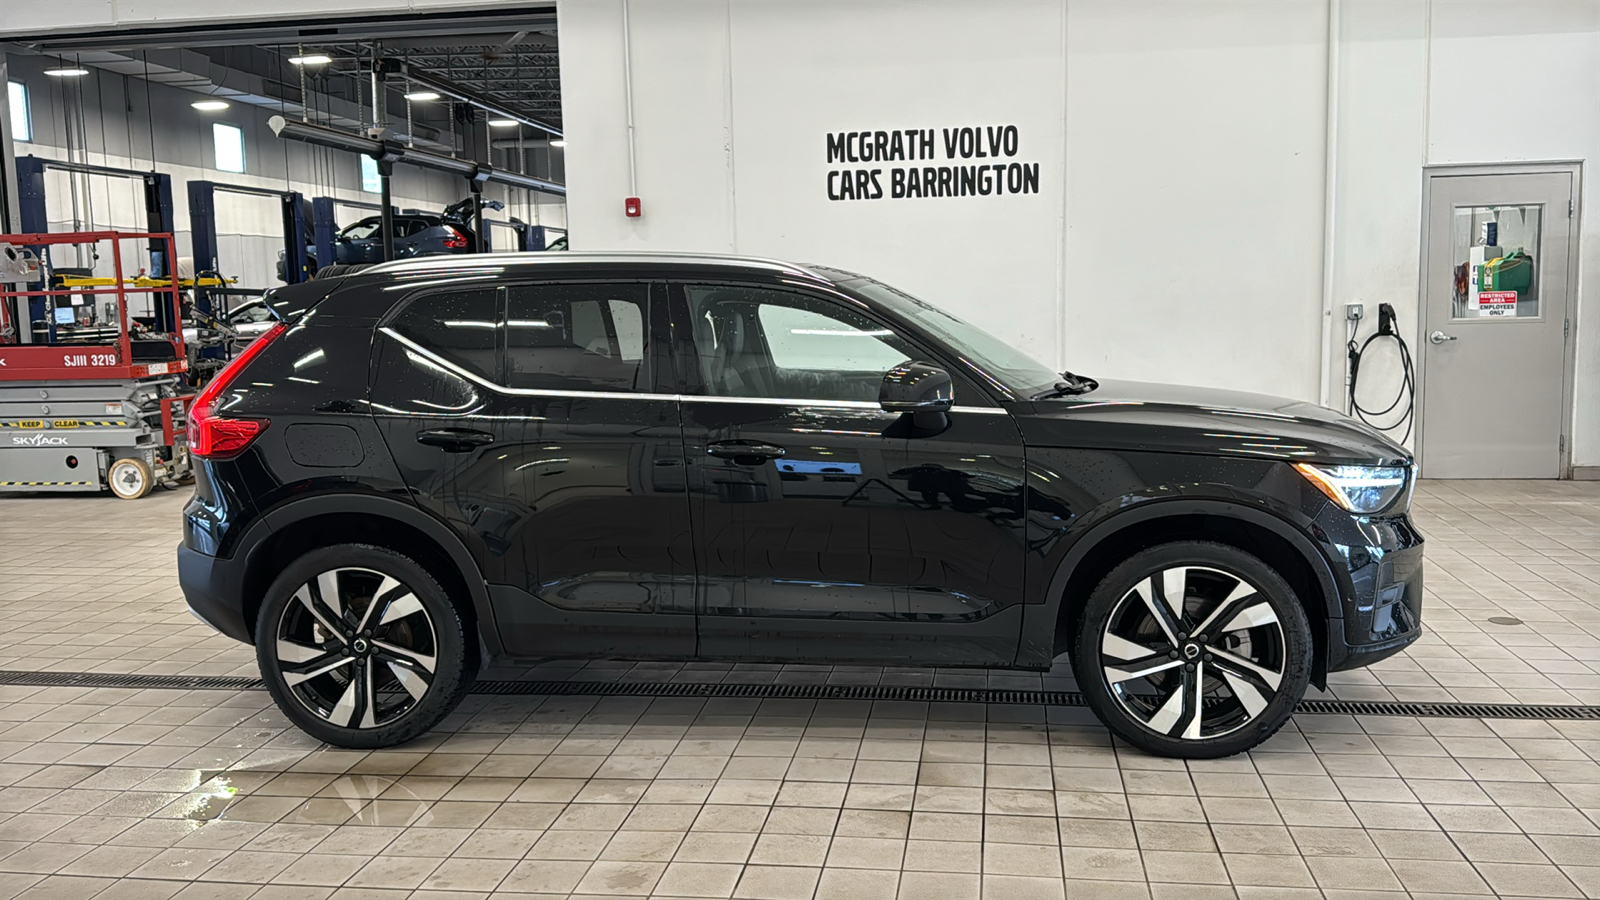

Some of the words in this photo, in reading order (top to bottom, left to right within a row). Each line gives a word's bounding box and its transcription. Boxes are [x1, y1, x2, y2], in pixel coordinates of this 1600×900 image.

[827, 129, 935, 163] MCGRATH
[943, 125, 1018, 159] VOLVO
[827, 169, 883, 201] CARS
[891, 163, 1039, 199] BARRINGTON
[91, 354, 116, 366] 3219
[12, 433, 69, 446] SKYJACK
